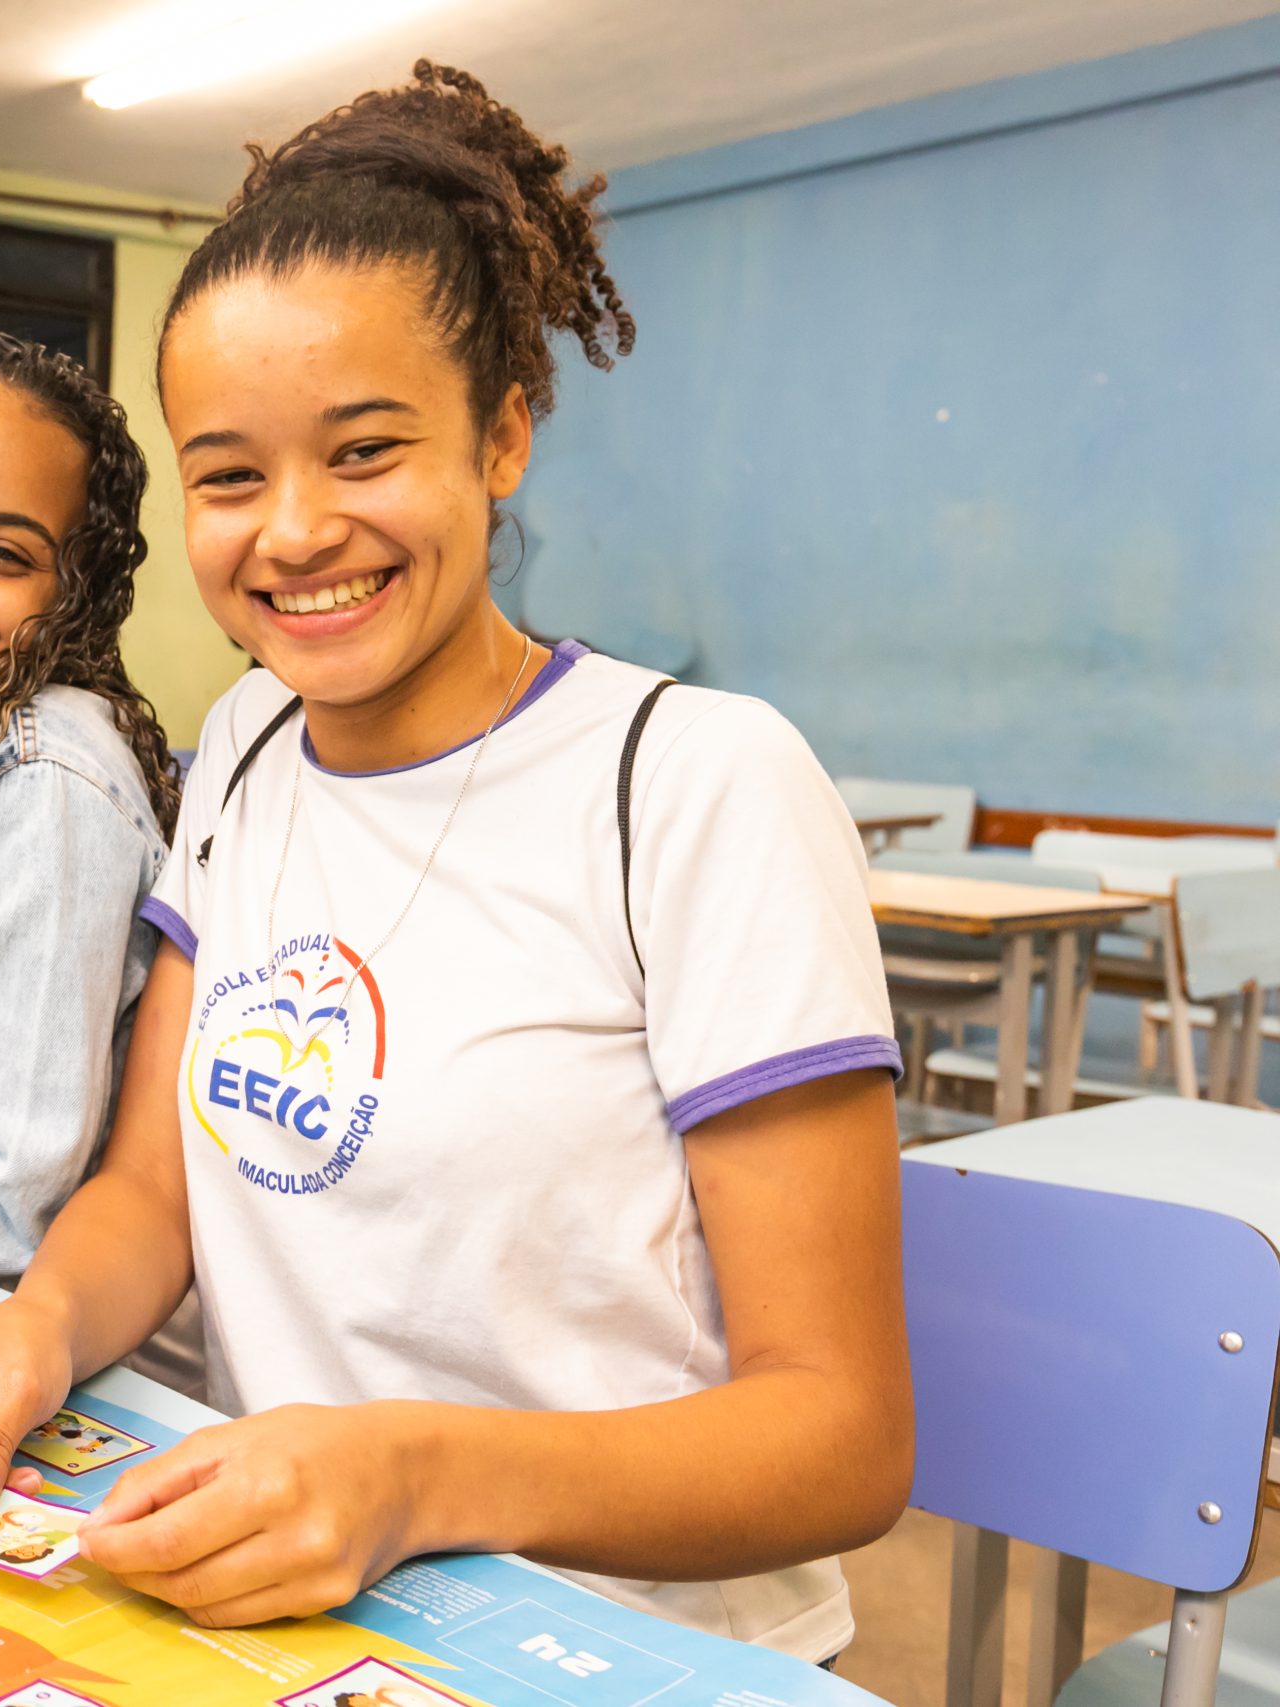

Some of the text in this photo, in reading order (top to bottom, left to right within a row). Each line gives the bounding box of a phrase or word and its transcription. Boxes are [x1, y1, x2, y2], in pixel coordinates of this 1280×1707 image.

[199, 933, 331, 1031] ESCOLA ESTADUAL
[209, 1058, 331, 1140] EEIC
[238, 1094, 379, 1195] IMACULADA CONCEIÇÃO
[517, 1632, 614, 1678] 24
